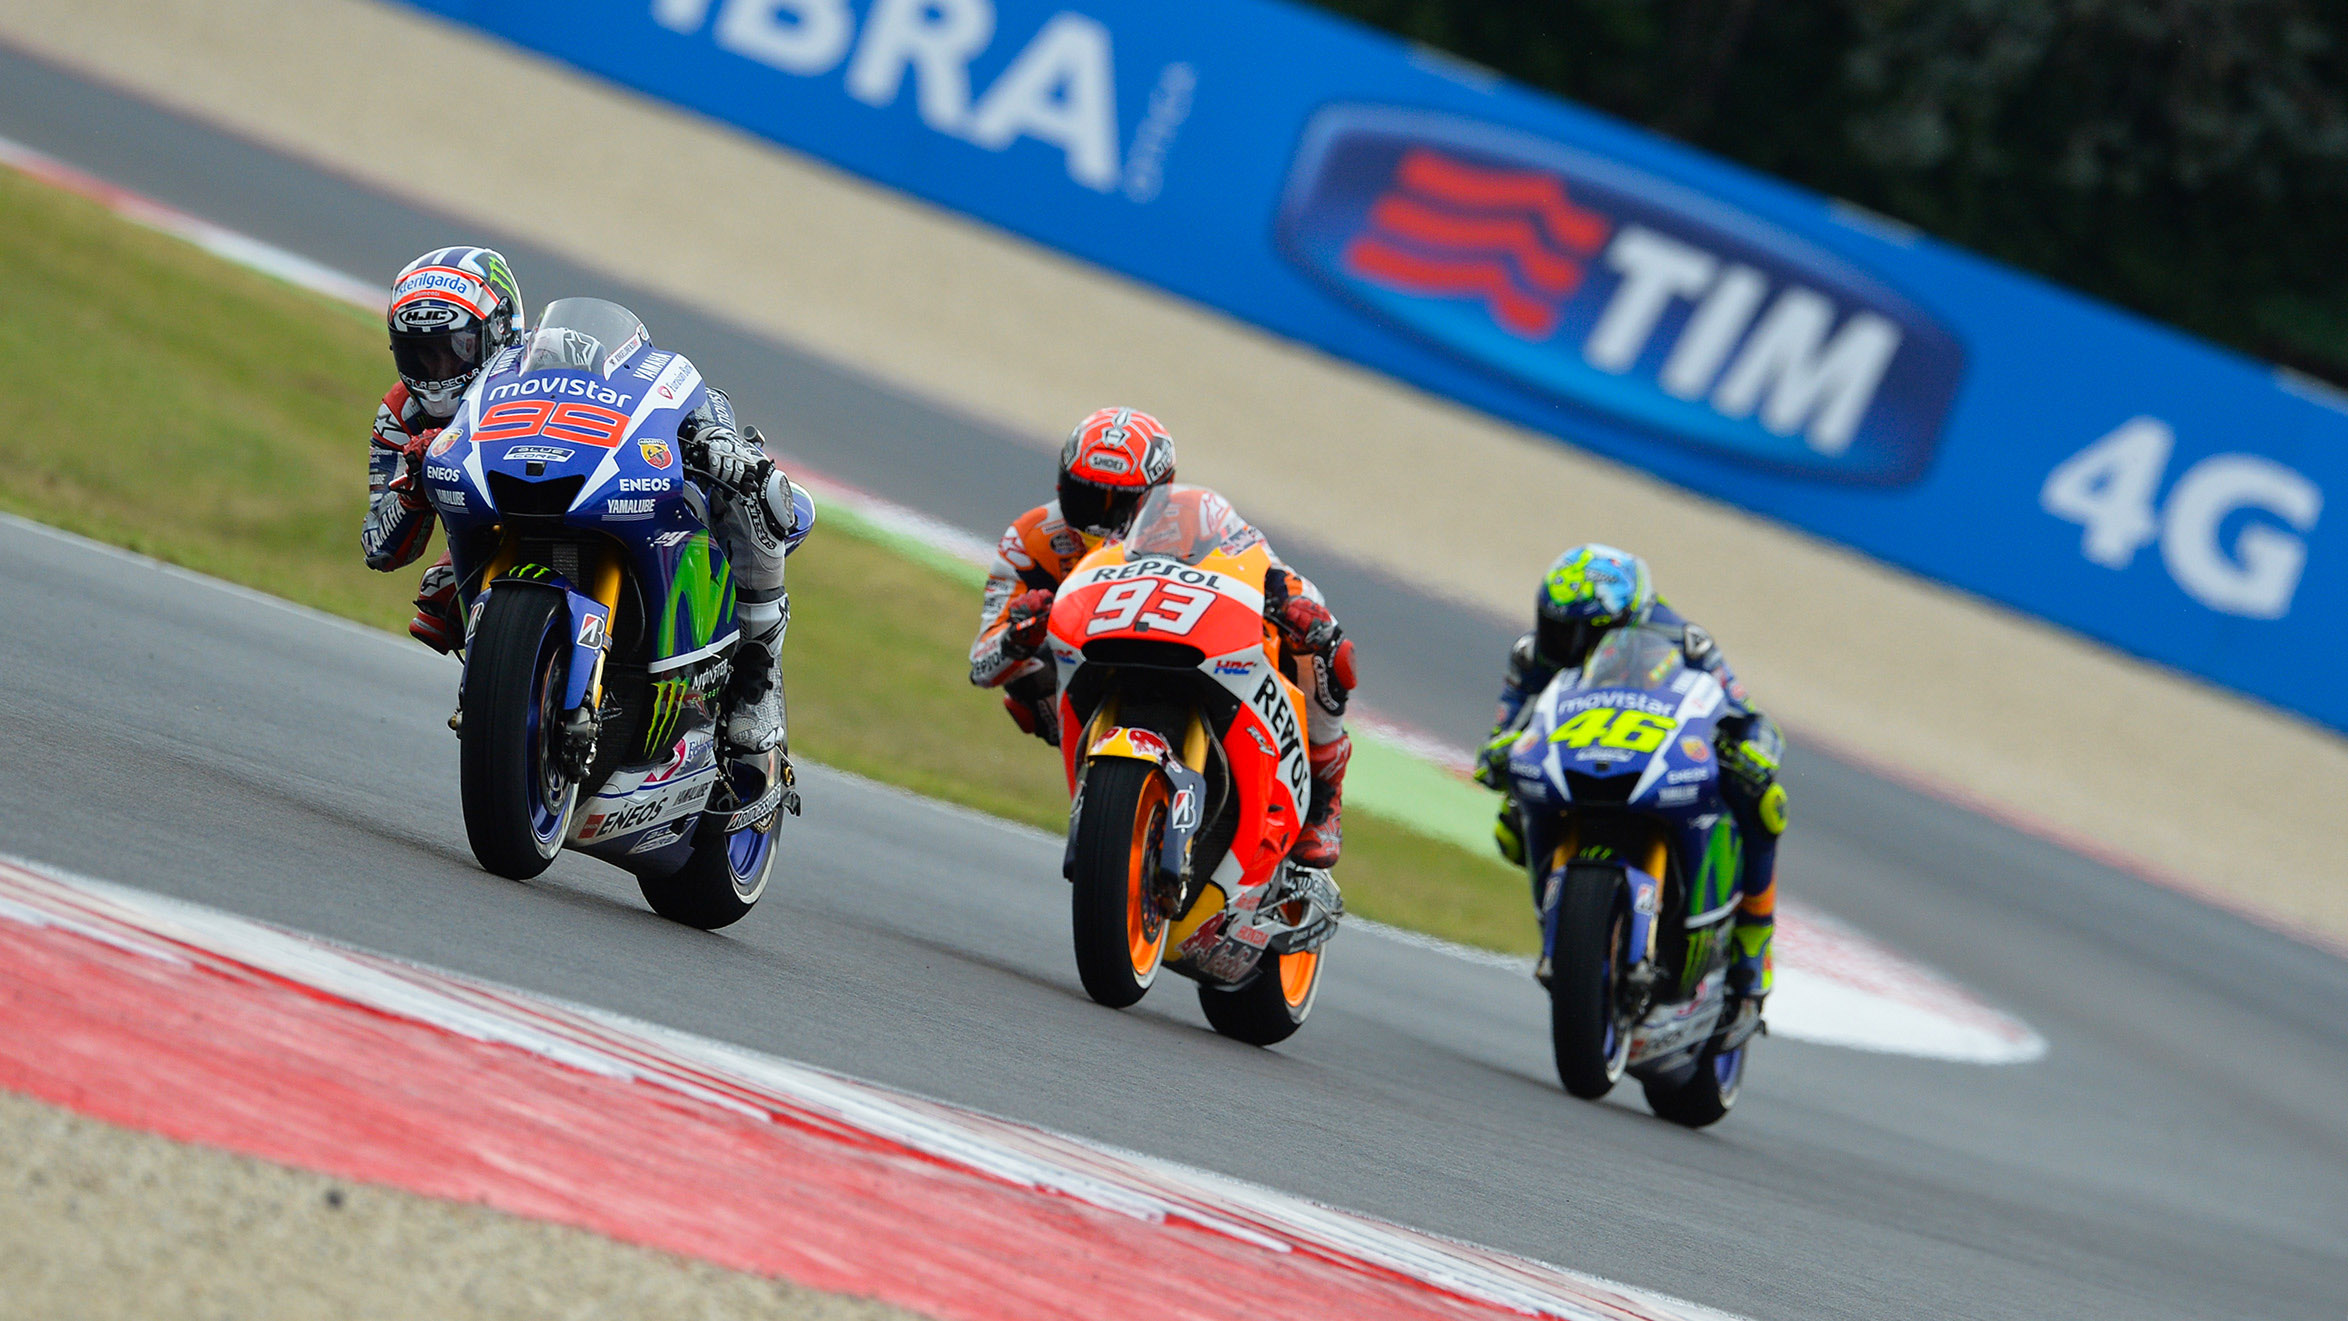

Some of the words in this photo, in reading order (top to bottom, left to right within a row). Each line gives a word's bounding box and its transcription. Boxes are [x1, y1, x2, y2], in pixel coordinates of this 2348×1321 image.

[399, 272, 467, 296] sterilgarda
[405, 311, 448, 321] HJC
[1586, 224, 1904, 457] TIM
[440, 367, 481, 390] SECTOR
[632, 351, 673, 382] YAMAHA
[488, 377, 633, 408] movistar
[470, 400, 632, 449] 99
[516, 447, 565, 456] BLUE
[427, 465, 461, 483] ENEOS
[619, 478, 671, 492] ENEOS
[607, 499, 656, 514] YAMALUBE
[2041, 415, 2323, 620] 4G
[1092, 561, 1220, 590] REPSOL
[1085, 577, 1218, 637] 93
[1558, 691, 1676, 717] movistar
[1254, 674, 1309, 808] REPSOL
[1547, 707, 1678, 754] 46
[597, 796, 669, 837] ENEOS
